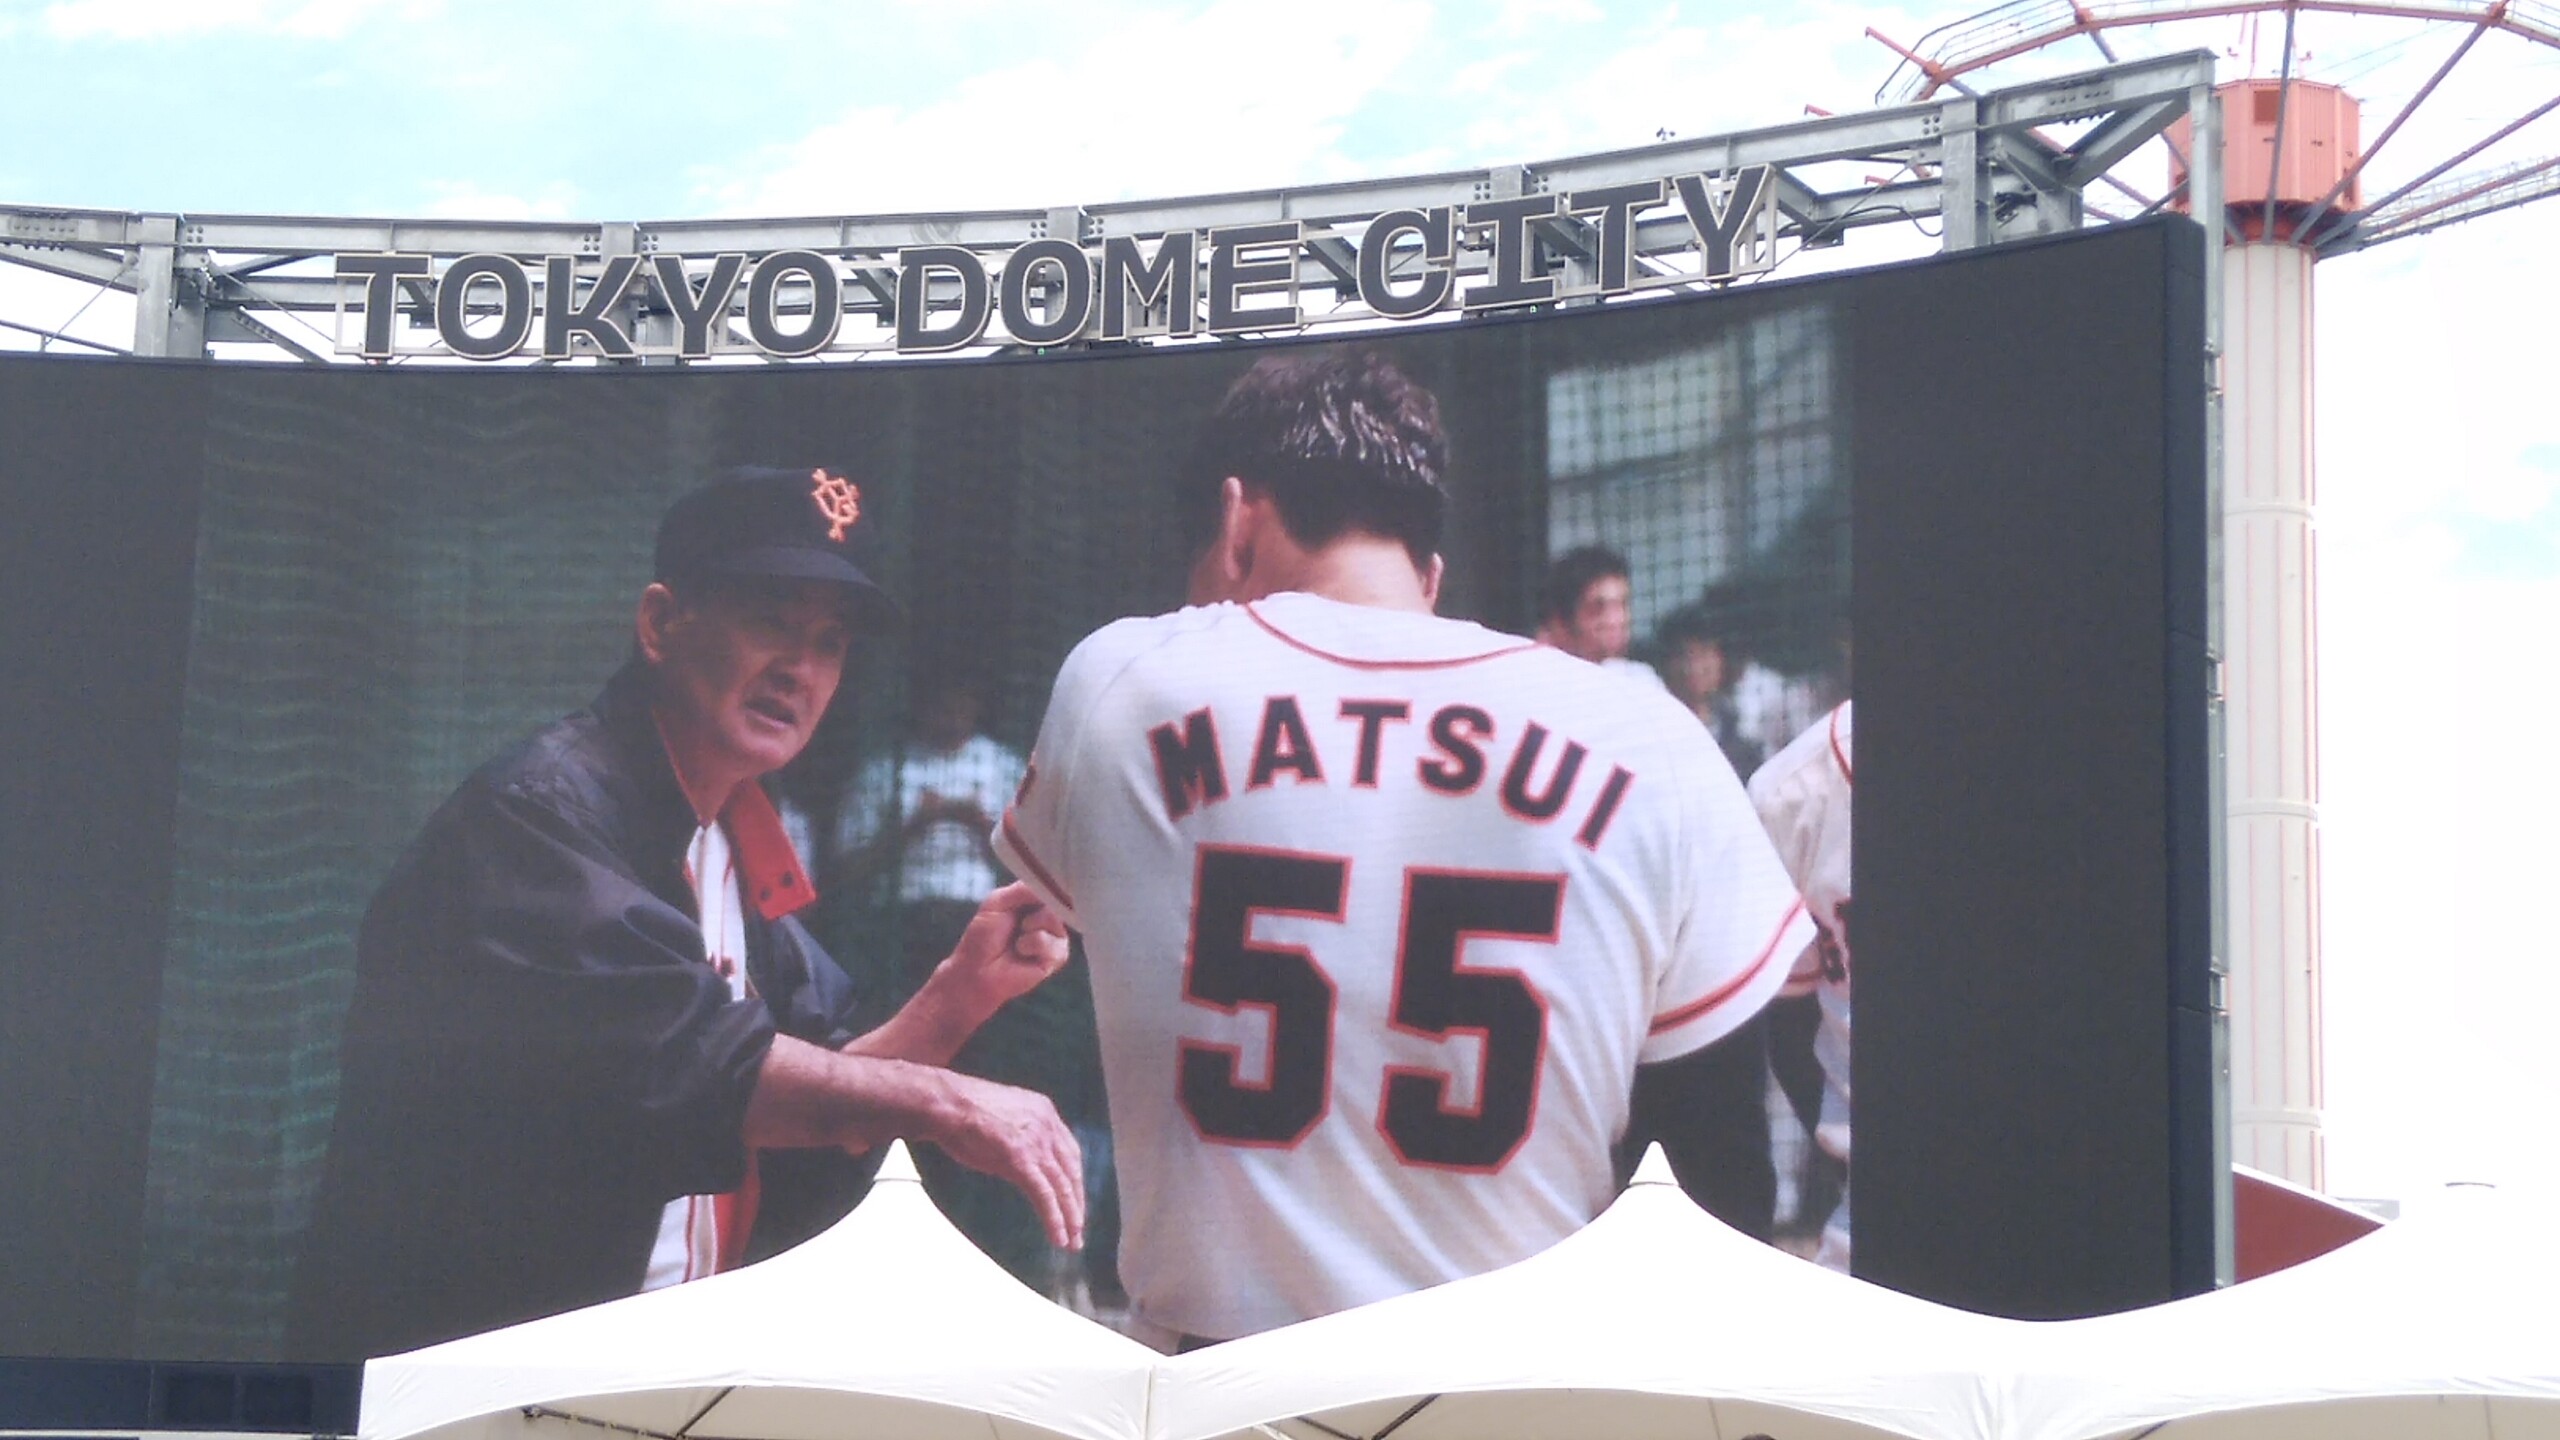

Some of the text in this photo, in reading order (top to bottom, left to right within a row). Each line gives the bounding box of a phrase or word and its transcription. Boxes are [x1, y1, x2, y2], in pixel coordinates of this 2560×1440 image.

[334, 164, 1777, 360] TOKYO DOME CITY
[1147, 695, 1636, 851] MATSUI
[1174, 842, 1568, 1175] 55
